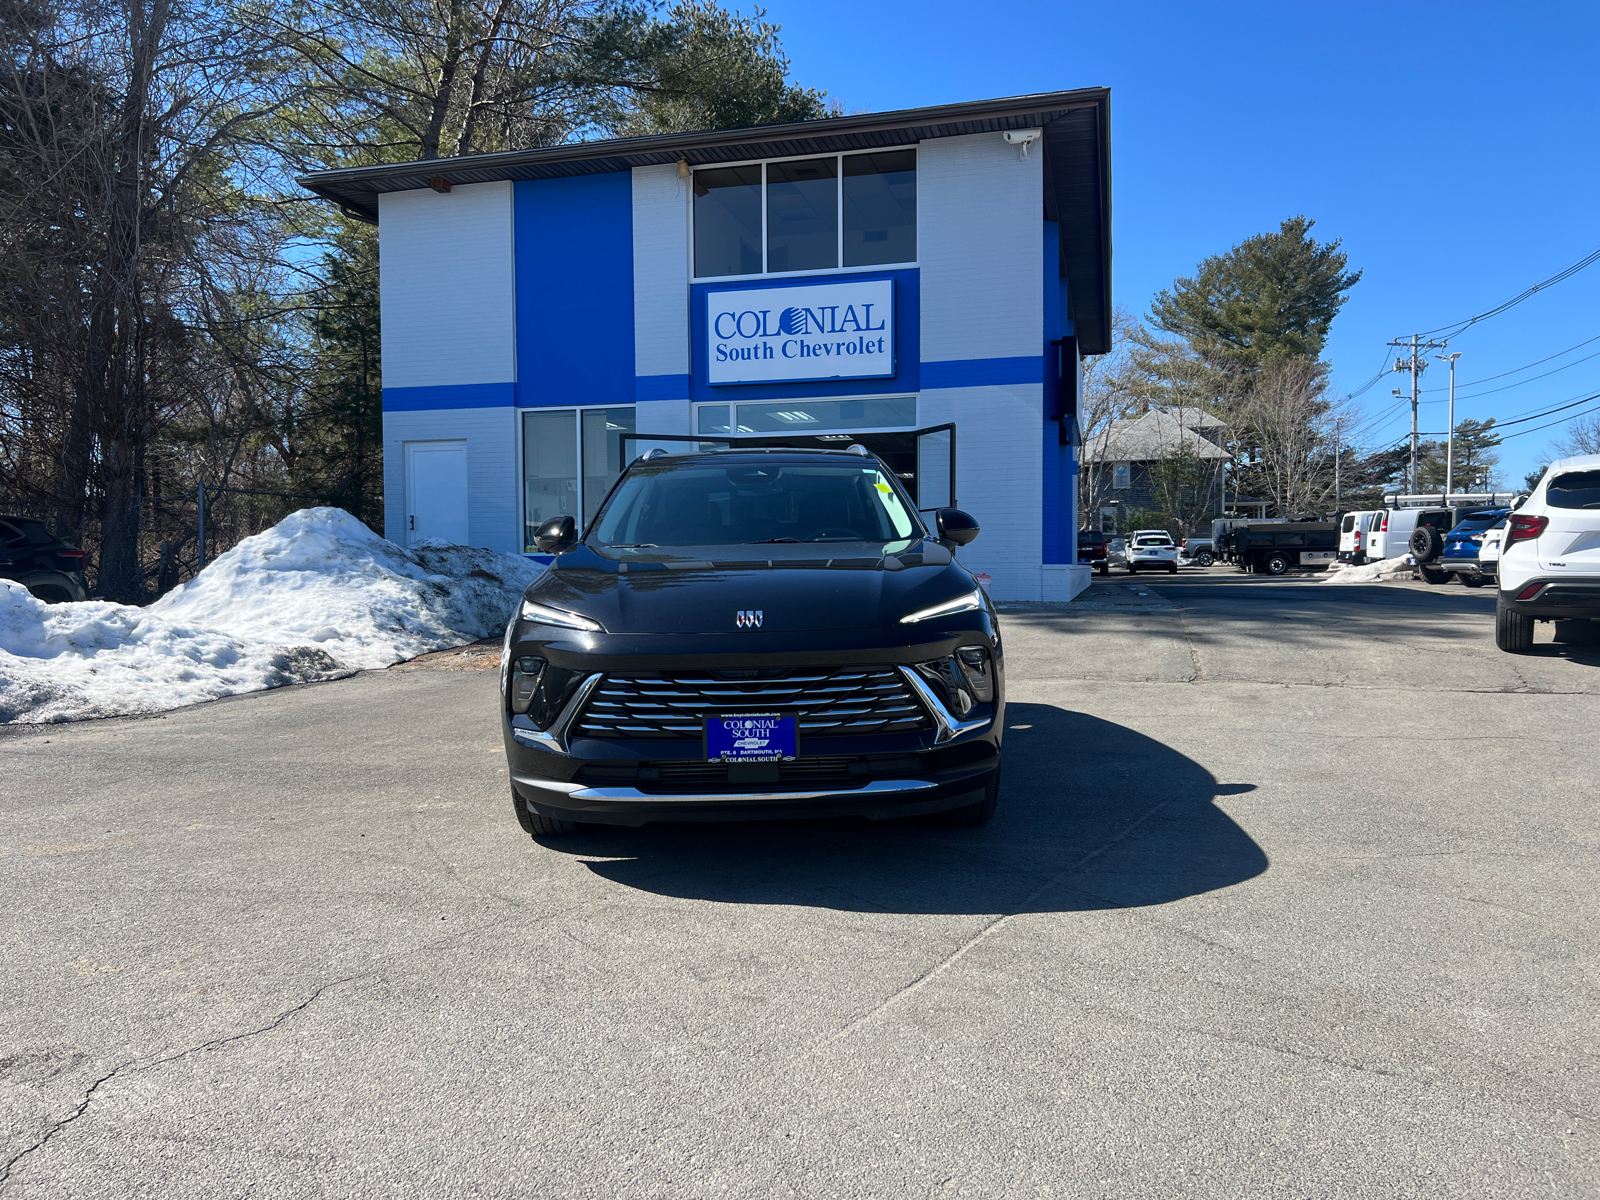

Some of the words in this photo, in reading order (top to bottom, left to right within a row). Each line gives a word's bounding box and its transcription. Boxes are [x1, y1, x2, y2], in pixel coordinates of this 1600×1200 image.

[714, 304, 885, 339] COLONIAL
[716, 342, 774, 362] South
[781, 336, 885, 359] Chevrolet
[723, 720, 779, 730] COLONIAL
[732, 729, 770, 738] SOUTH
